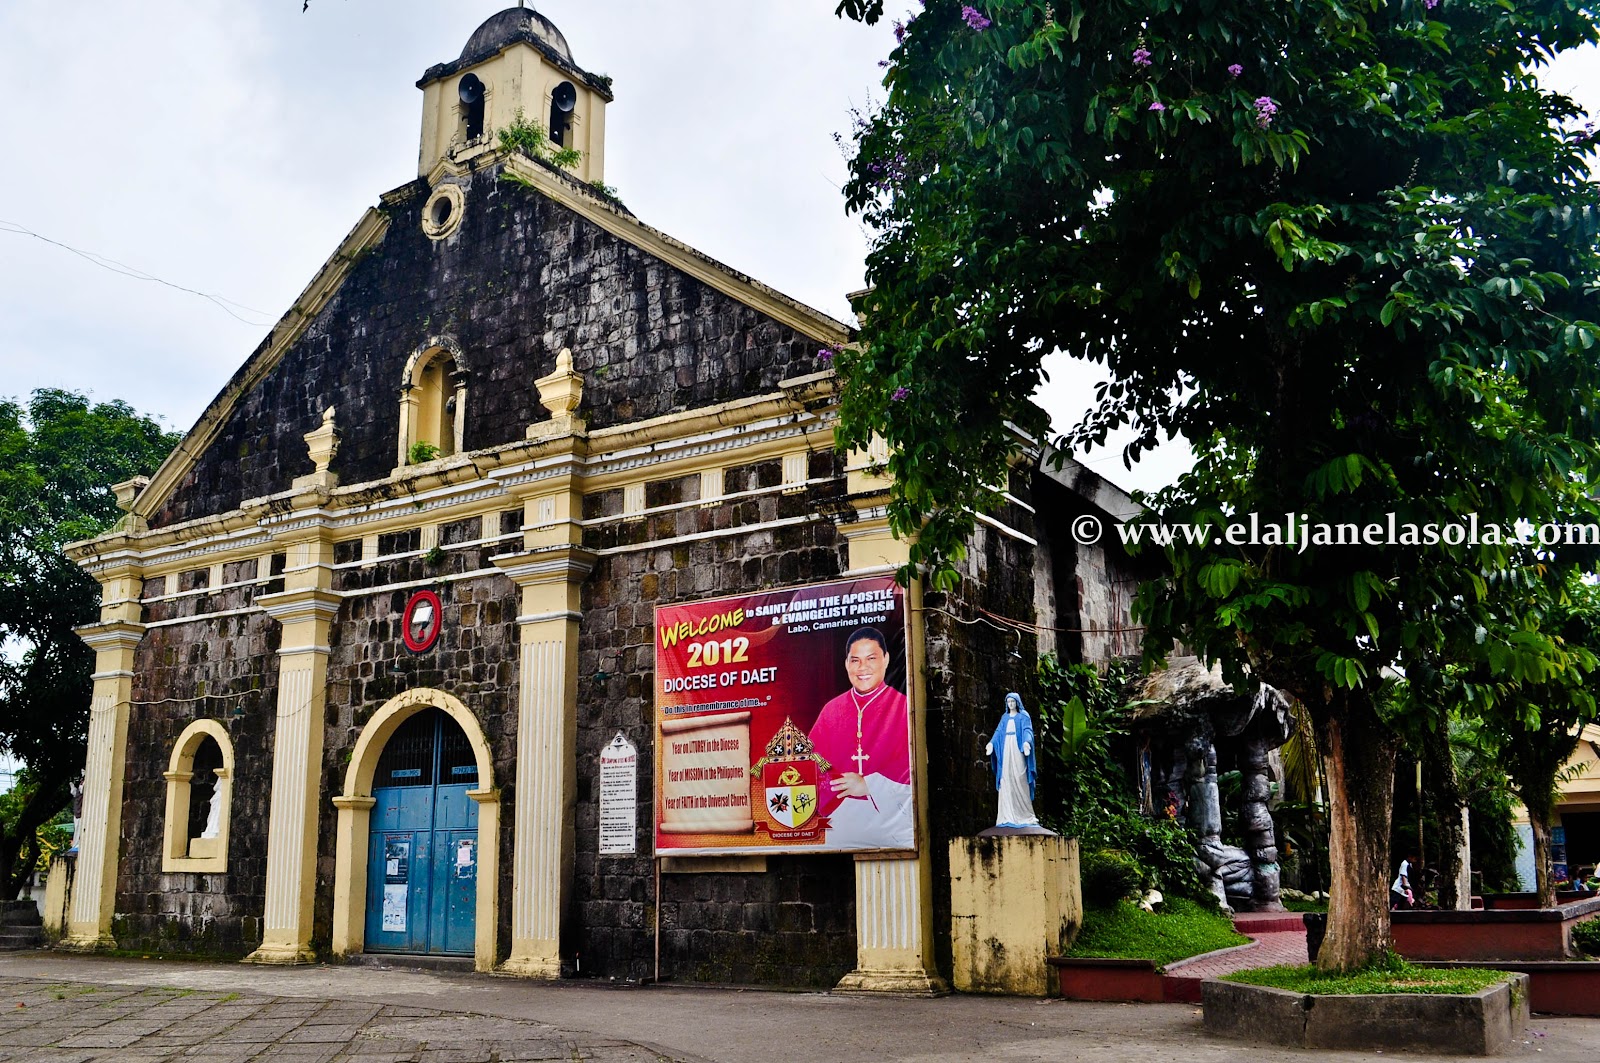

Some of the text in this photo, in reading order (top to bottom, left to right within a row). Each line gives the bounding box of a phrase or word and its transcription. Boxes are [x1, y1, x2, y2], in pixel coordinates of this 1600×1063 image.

[660, 588, 894, 649] WELCOME to SAINT JOHN THE APOSTLE
[772, 599, 895, 626] & EVANGELIST PARISH
[787, 614, 887, 634] Labo, Camarines Norte
[687, 637, 749, 668] 2012
[664, 667, 777, 693] DIOCESE OF DAET
[674, 704, 685, 713] this
[686, 704, 693, 712] in
[693, 700, 739, 712] remembrance
[740, 698, 748, 707] of
[672, 741, 683, 755] Year
[707, 739, 711, 752] in
[712, 738, 720, 751] the
[720, 738, 739, 751] Diocese
[668, 769, 679, 783] Year
[685, 767, 703, 781] MISSION
[704, 767, 708, 780] in
[709, 766, 717, 780] the
[717, 765, 743, 780] Philippines
[665, 796, 675, 810] Year
[682, 795, 694, 809] FAITH
[694, 795, 699, 808] in
[700, 795, 708, 808] the
[708, 793, 730, 808] Universal
[730, 793, 748, 807] Church
